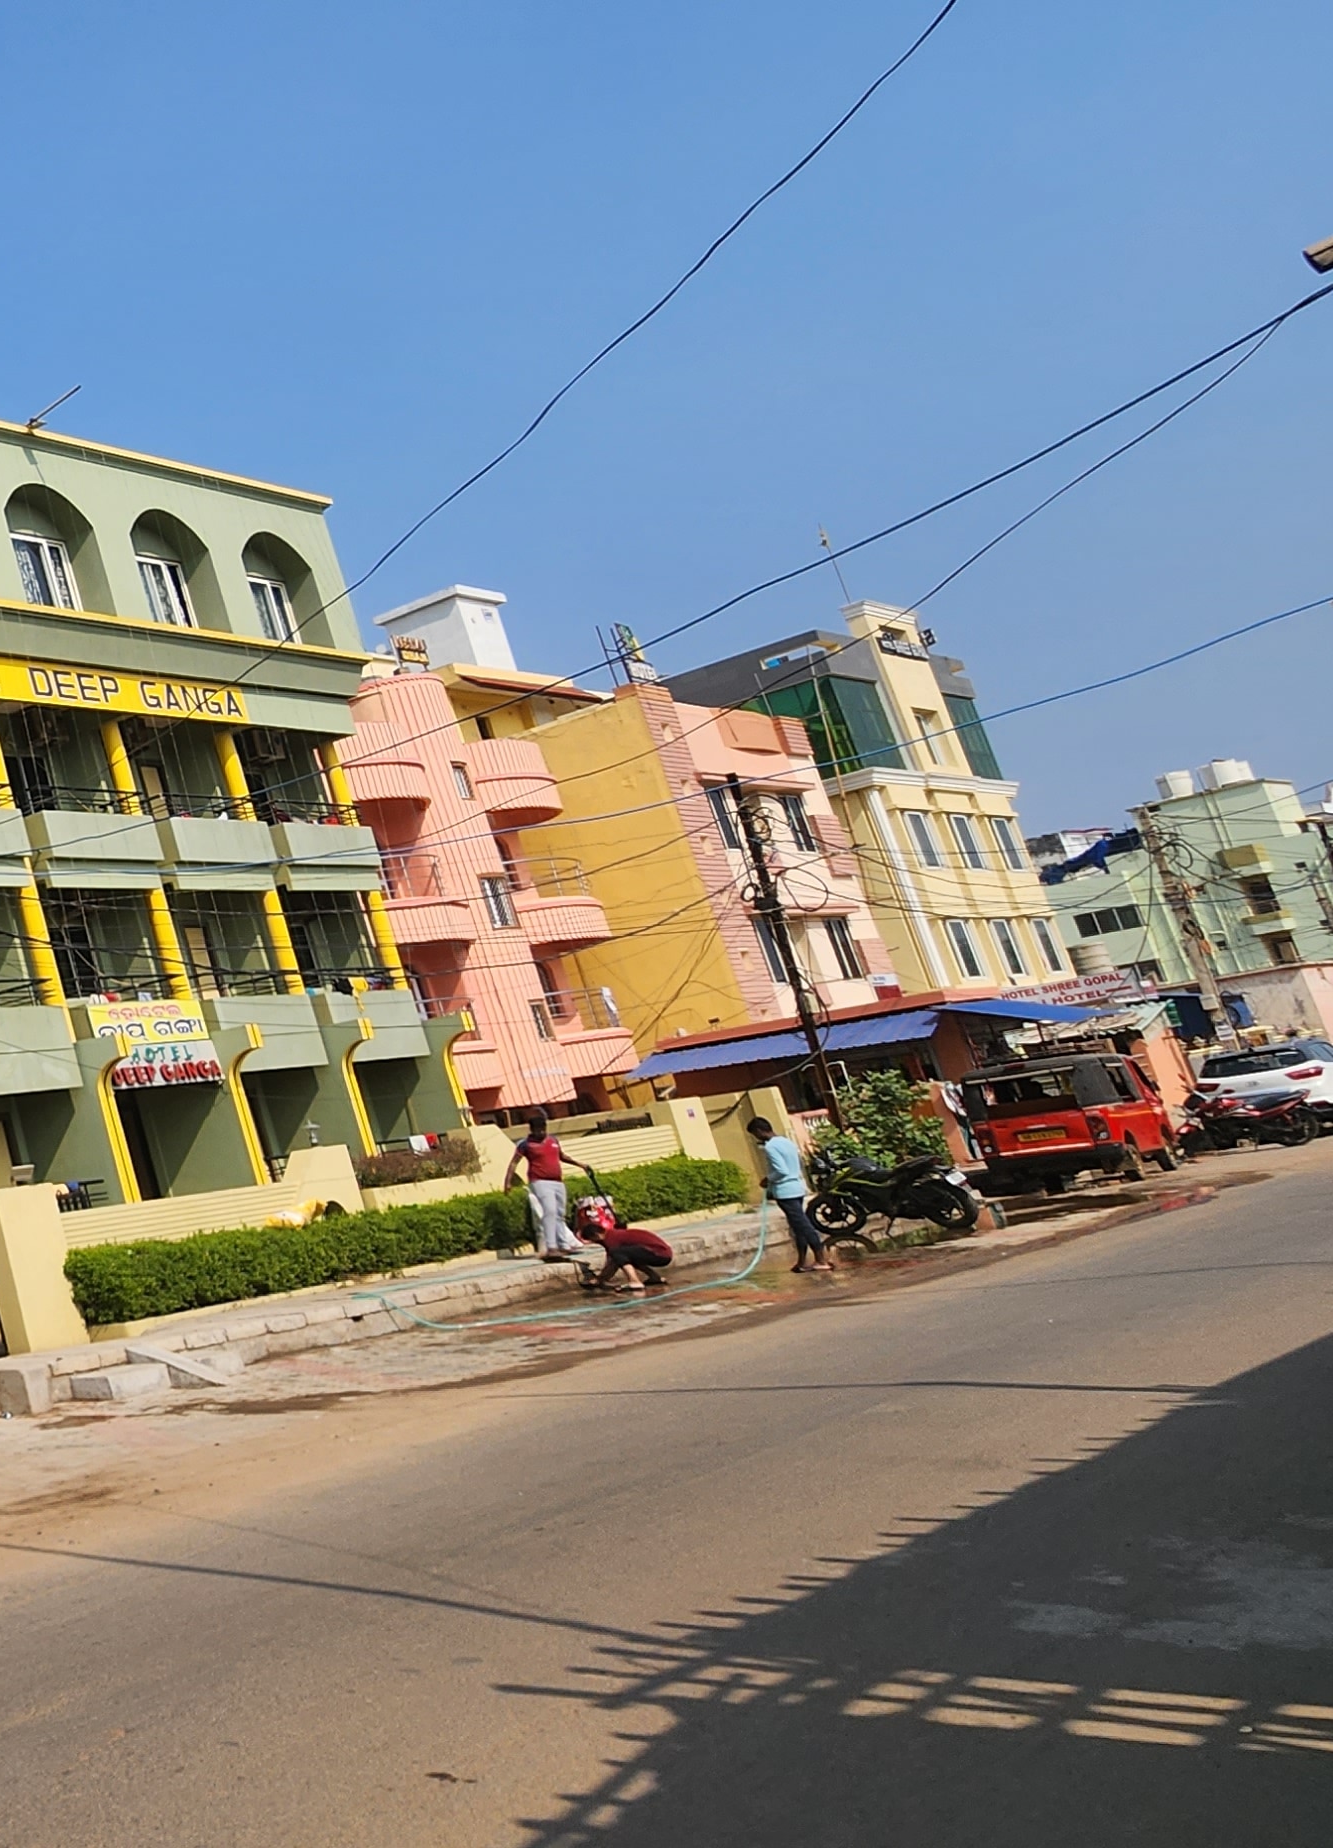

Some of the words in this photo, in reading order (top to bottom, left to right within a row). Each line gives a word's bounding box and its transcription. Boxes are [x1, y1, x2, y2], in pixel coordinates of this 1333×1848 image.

[27, 666, 121, 704] DEEP
[139, 680, 245, 719] GANGA
[1001, 987, 1037, 1001] HOTEL
[1041, 980, 1081, 994] SHREE
[1084, 973, 1125, 987] GOPAL
[159, 1059, 222, 1083] GANGA
